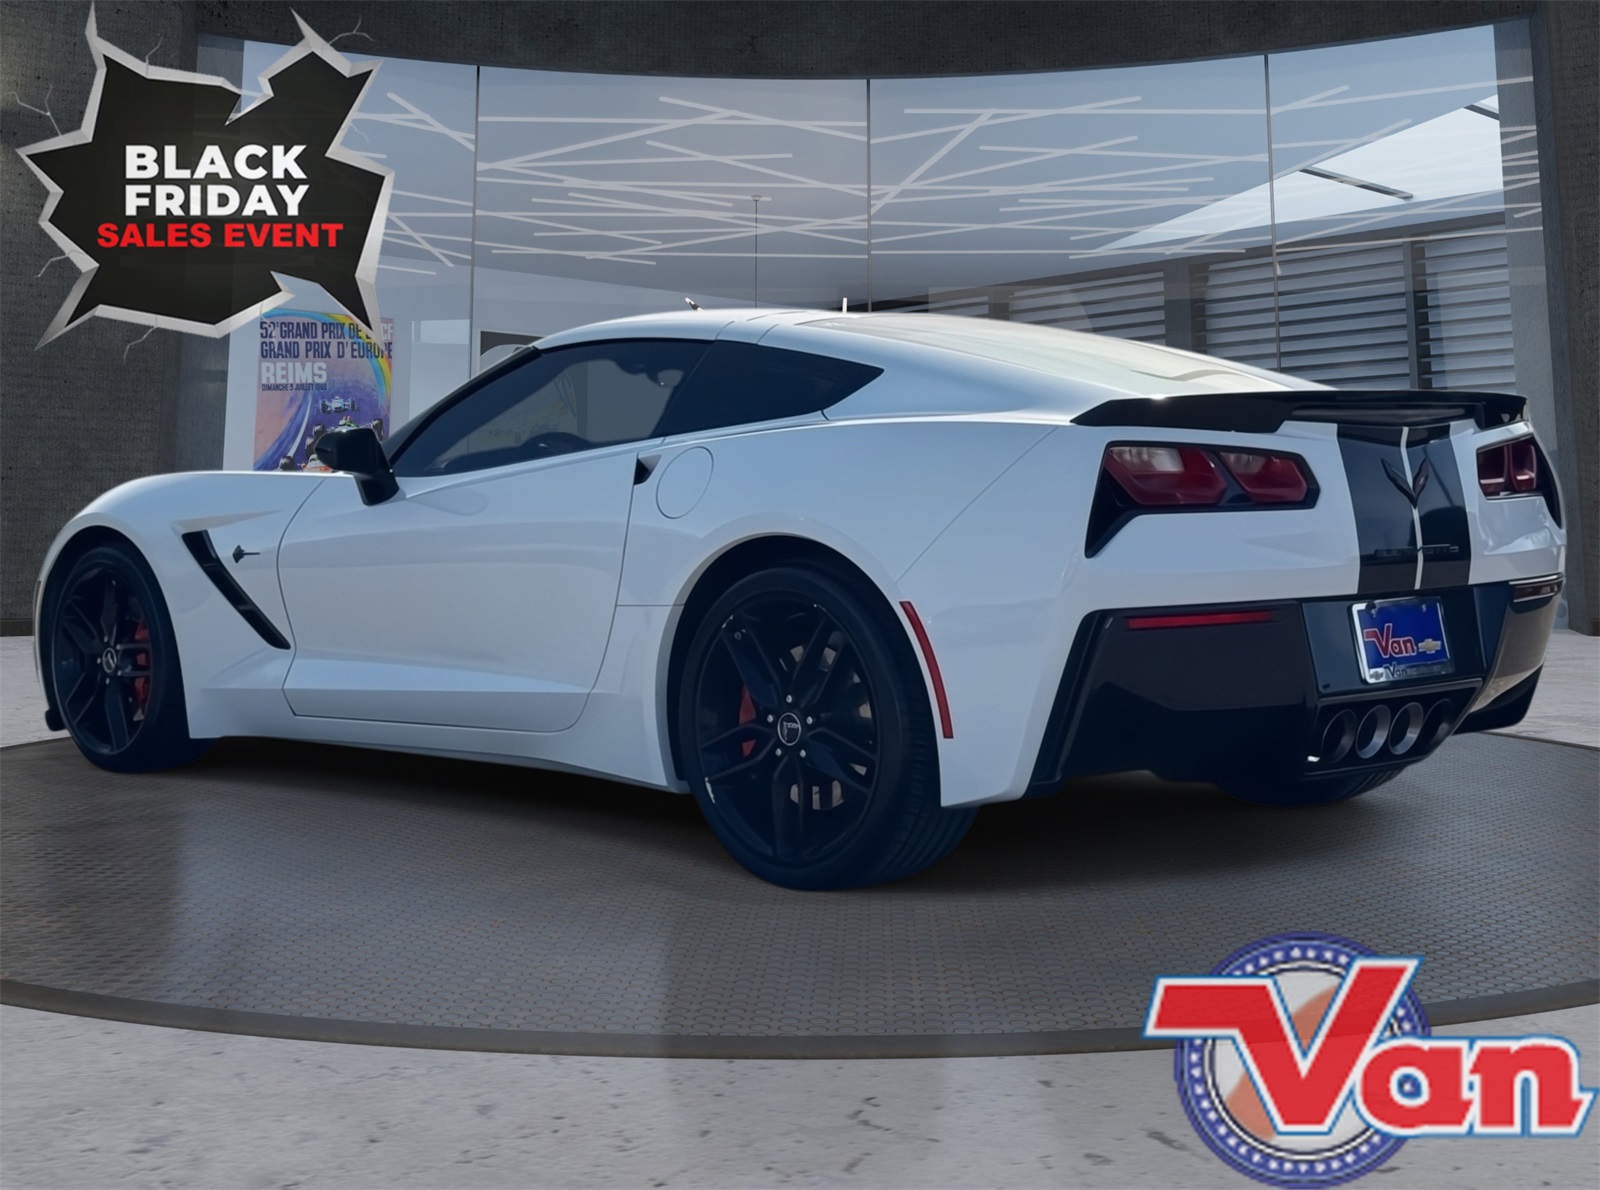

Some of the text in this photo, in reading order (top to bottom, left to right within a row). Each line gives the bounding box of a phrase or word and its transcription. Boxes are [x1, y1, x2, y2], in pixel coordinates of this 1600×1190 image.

[280, 322, 318, 339] GRAND
[321, 322, 345, 339] PRIX
[348, 322, 362, 340] DE
[260, 341, 299, 359] GRAND
[305, 341, 331, 359] PRIX
[261, 361, 328, 383] REIMS
[262, 383, 289, 391] DIMANCHE
[294, 383, 314, 391] JUILLET
[1363, 623, 1417, 658] Van
[1383, 662, 1407, 678] Van
